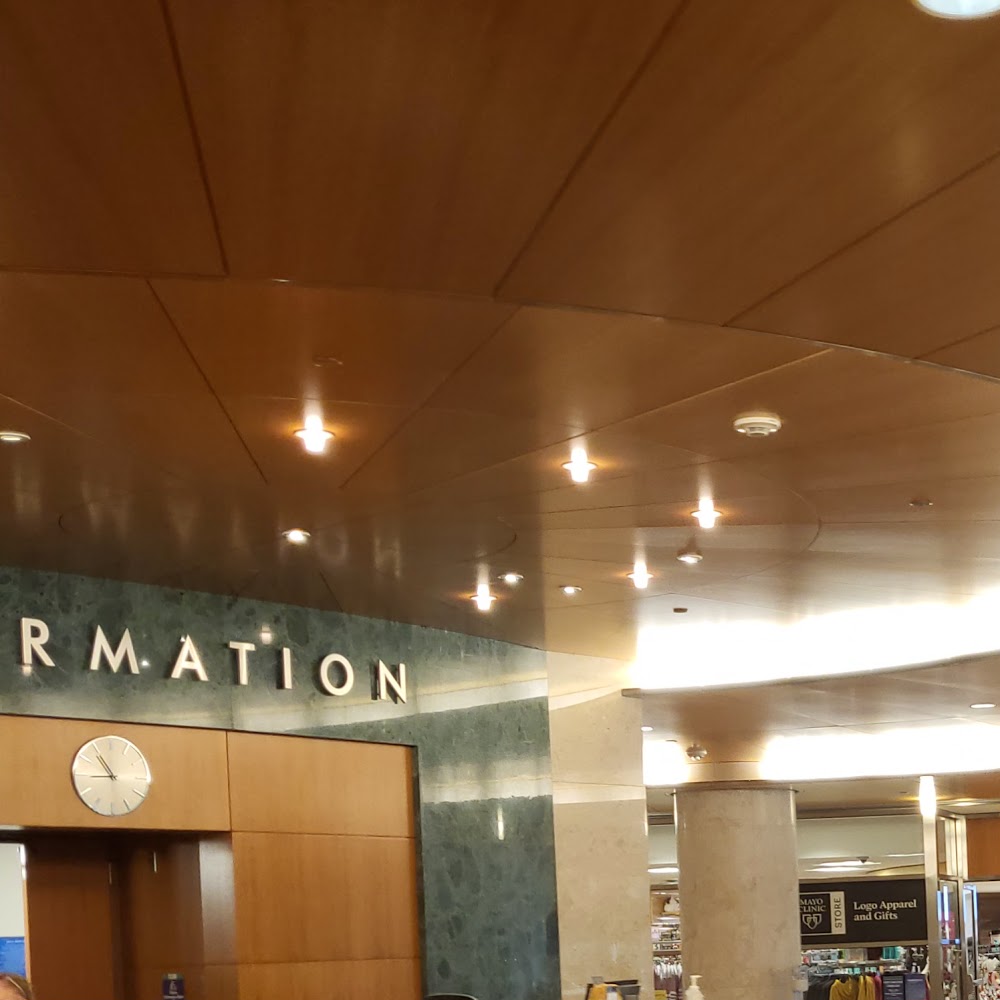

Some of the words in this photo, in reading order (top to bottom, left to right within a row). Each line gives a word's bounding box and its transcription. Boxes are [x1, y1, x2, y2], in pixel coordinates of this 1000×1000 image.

[20, 617, 407, 703] RMATION
[833, 897, 843, 929] STORE
[853, 901, 878, 912] Logo
[879, 899, 917, 911] Apparel
[854, 912, 872, 921] and
[874, 911, 899, 921] Gifts
